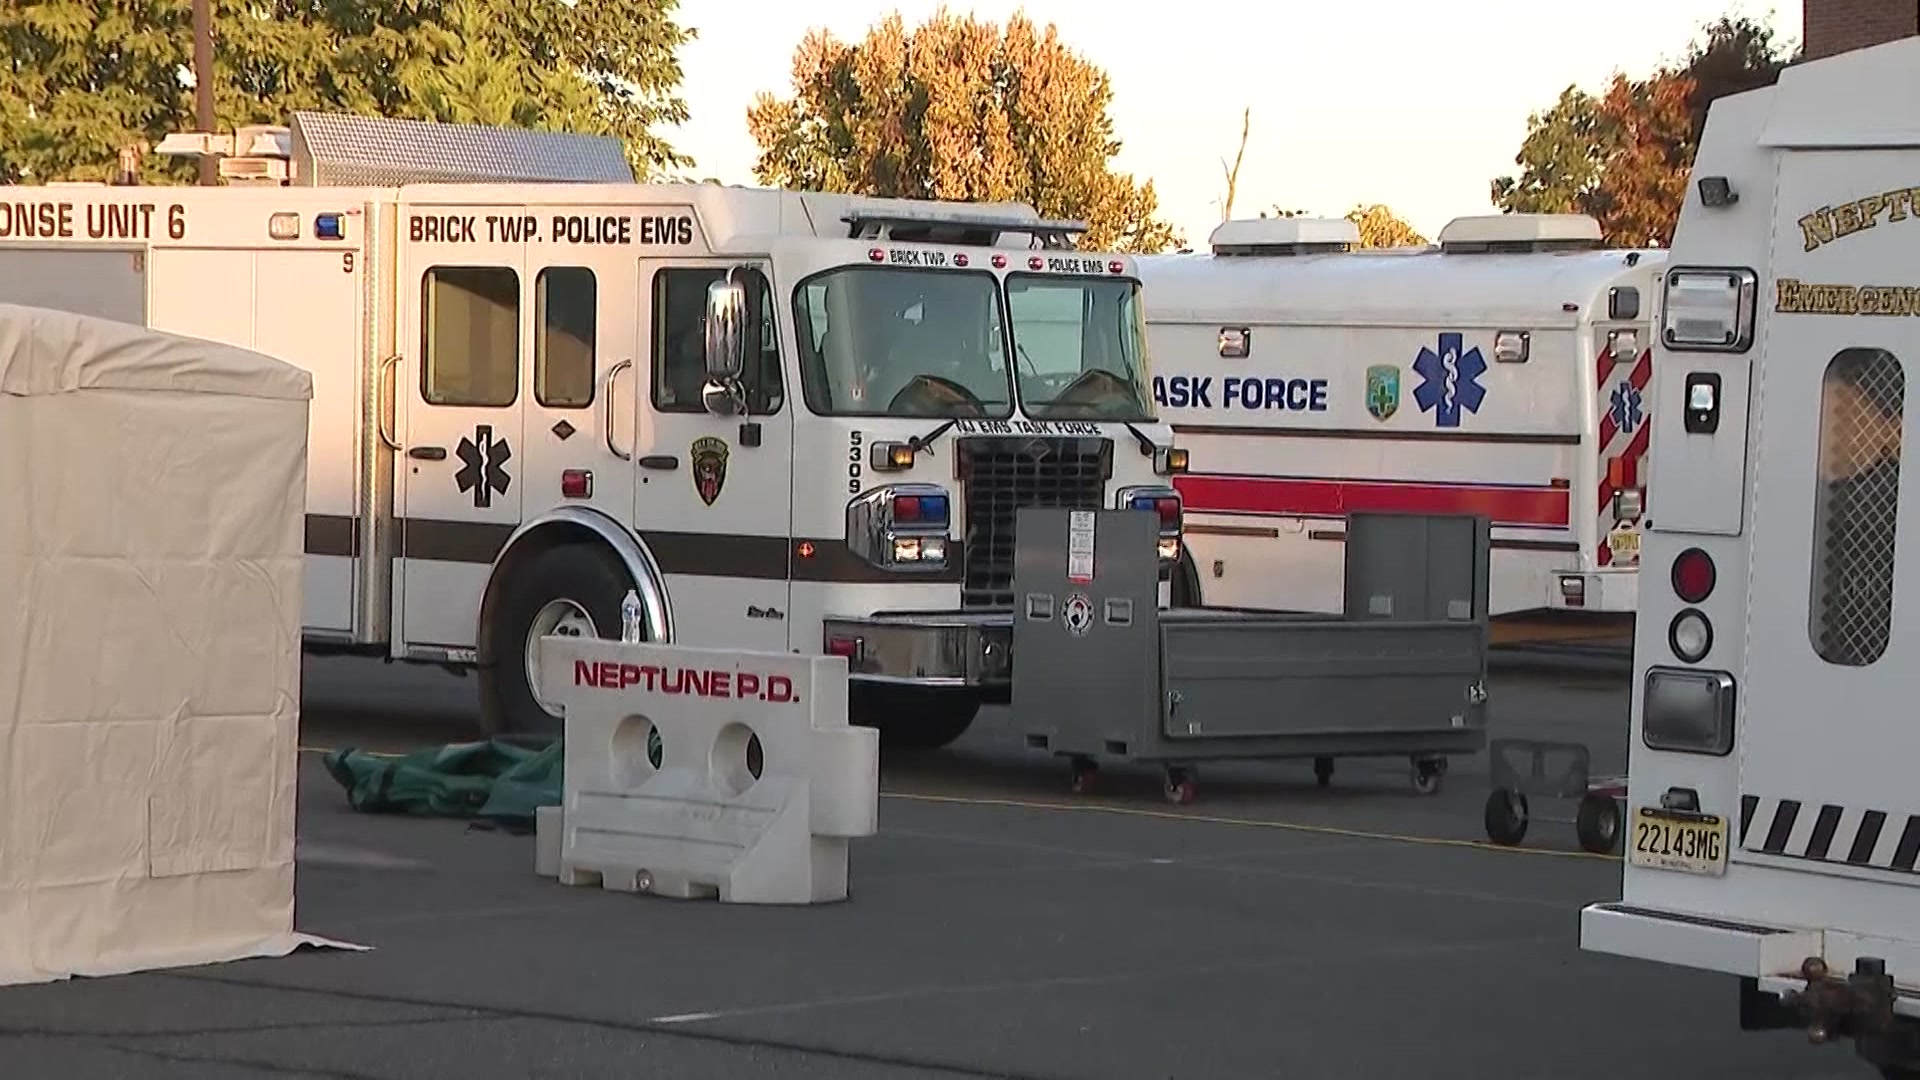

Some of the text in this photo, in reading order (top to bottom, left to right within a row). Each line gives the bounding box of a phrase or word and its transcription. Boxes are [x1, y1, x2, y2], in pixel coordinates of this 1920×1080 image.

[0, 202, 185, 239] ONSE UNIT 6
[409, 215, 693, 245] BRICK TWP. POLICE EMS
[343, 252, 354, 273] 9
[889, 249, 949, 267] BRICK TWP.
[1047, 257, 1104, 274] POLICE EMS
[1223, 378, 1328, 411] FORCE
[980, 420, 1011, 434] EMS
[1014, 421, 1053, 434] TASK
[1054, 421, 1102, 435] FORCE
[849, 431, 862, 494] 5309
[574, 660, 800, 703] NEPTUNE P.D.
[1637, 822, 1720, 861] 22143MG
